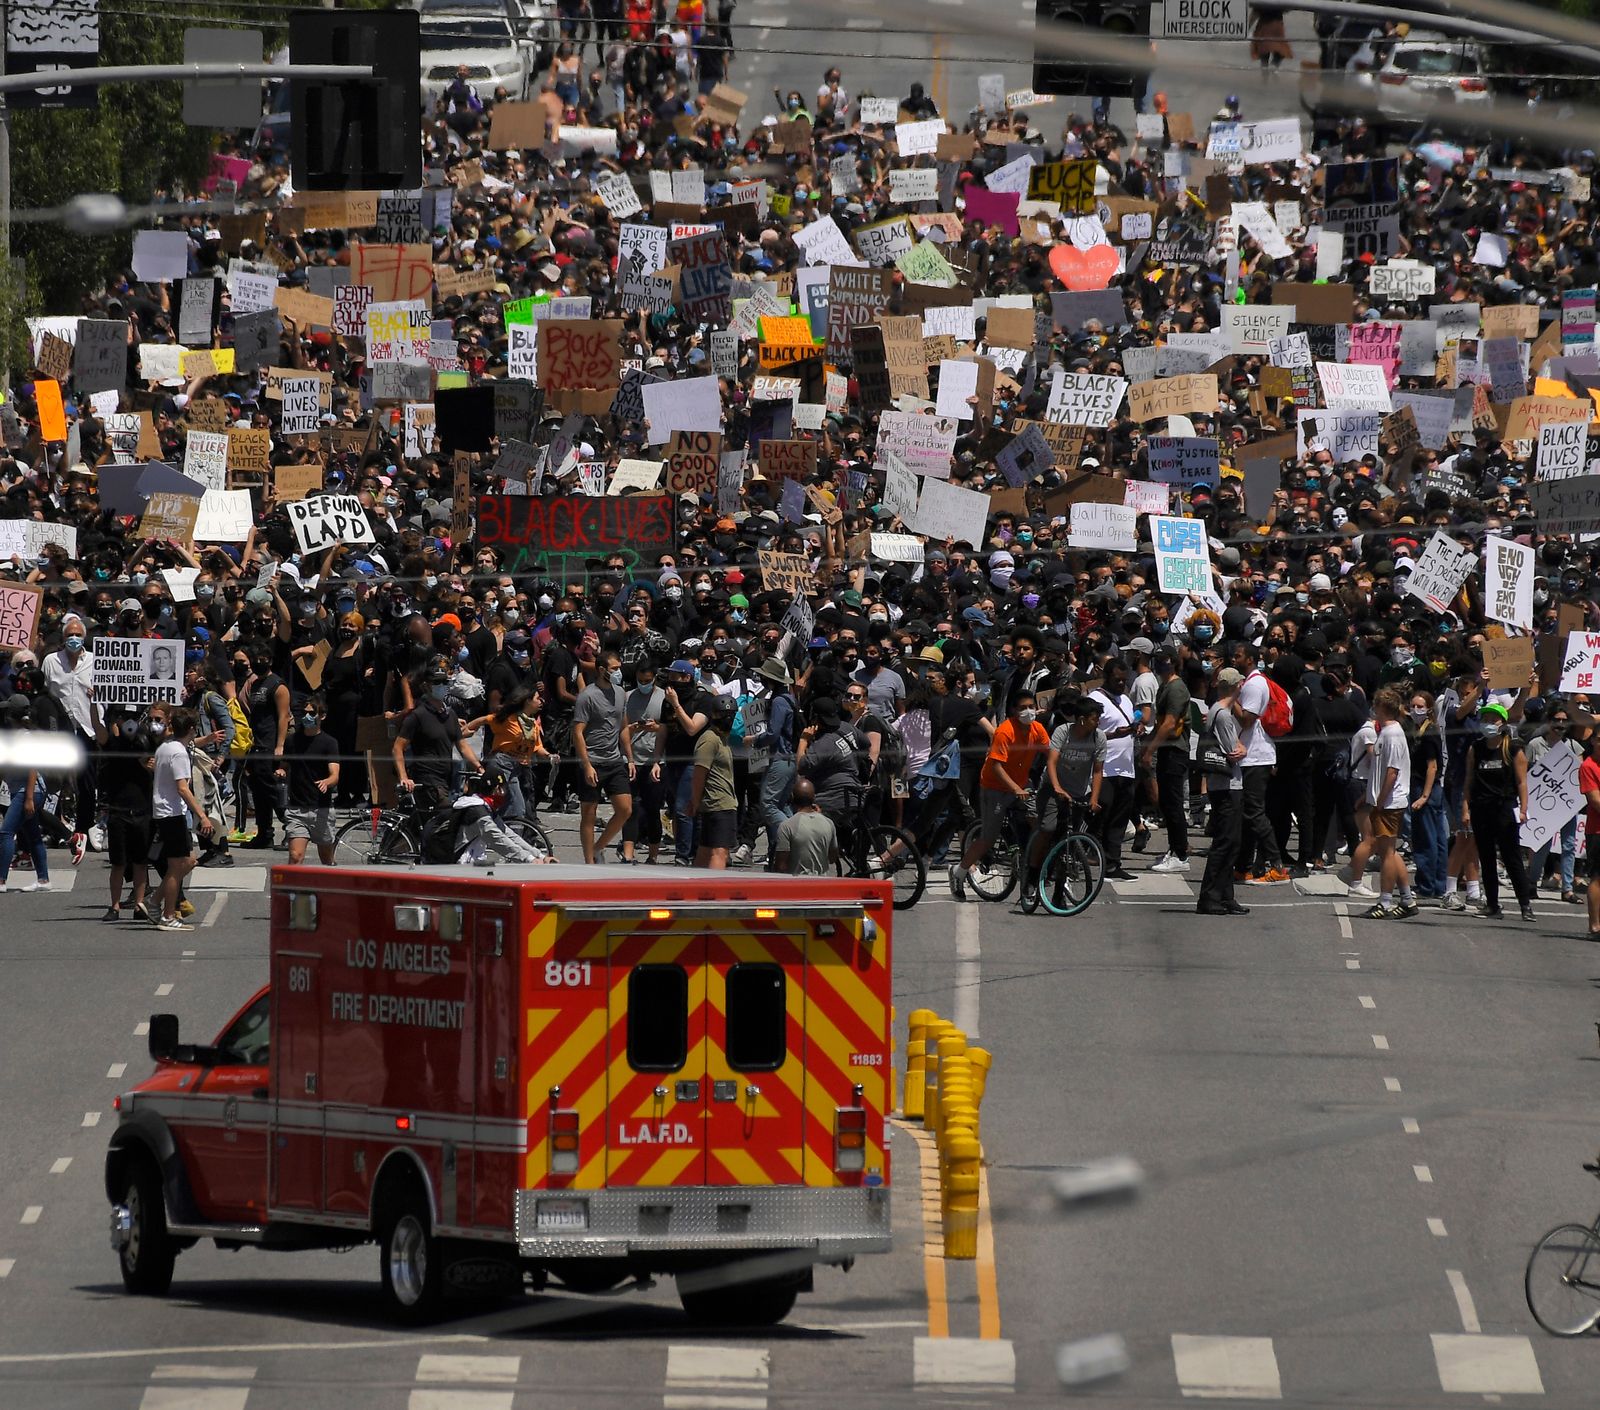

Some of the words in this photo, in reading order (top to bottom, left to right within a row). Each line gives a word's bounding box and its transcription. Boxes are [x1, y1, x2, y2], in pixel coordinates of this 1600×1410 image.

[1179, 0, 1231, 19] BLOCK
[1167, 21, 1243, 35] INTERSECTION
[1031, 161, 1097, 192] FUCK
[738, 187, 759, 202] HOW
[379, 199, 420, 214] ASIANS
[1326, 207, 1365, 222] JACKIE
[1345, 219, 1379, 233] MUST
[620, 239, 642, 249] FOR
[625, 273, 672, 290] RACISM
[834, 272, 882, 291] WHITE
[1374, 268, 1422, 282] STOP
[335, 286, 374, 303] DEATH
[1374, 280, 1432, 293] KILLING
[829, 290, 891, 306] SUPREMACY
[334, 310, 367, 323] POLIC
[368, 311, 409, 329] BLACK
[409, 310, 432, 328] LIVES
[1232, 315, 1281, 327] SILENCE
[336, 322, 367, 335] STAT
[372, 327, 431, 343] MATTER
[1243, 329, 1275, 341] KILLS
[545, 326, 611, 361] Black
[1269, 335, 1309, 355] BLACK
[512, 352, 535, 362] LIV
[762, 346, 795, 361] BLACK
[1272, 352, 1309, 367] LIVES
[510, 364, 535, 376] MATT
[1320, 365, 1341, 379] NO
[284, 380, 316, 395] BLACK
[1063, 374, 1118, 393] BLACK
[1131, 381, 1176, 401] BLACK
[1325, 381, 1345, 396] NO
[283, 395, 318, 412] LIVES
[1060, 393, 1113, 409] LIVES
[1143, 393, 1207, 416] MATTER
[1049, 408, 1113, 427] MATTER
[1517, 402, 1587, 418] AMERICAN
[283, 414, 319, 432] MATTER
[1330, 416, 1379, 432] JUSTICE
[230, 432, 266, 445] BLACK
[677, 431, 713, 453] NO
[1336, 434, 1378, 452] PEACE
[1543, 425, 1582, 446] BLACK
[232, 445, 266, 457] LIVES
[762, 442, 813, 460] BLACK
[1176, 448, 1219, 459] JUSTICE
[1541, 446, 1580, 468] LIVES
[227, 456, 265, 470] MATTER
[669, 453, 718, 476] GOOD
[768, 459, 810, 472] LIVES
[1181, 466, 1212, 478] PEACE
[671, 473, 718, 498] COPS
[293, 496, 362, 520] DEFUND
[1072, 506, 1097, 520] Jail
[1102, 507, 1135, 521] those
[32, 523, 69, 536] BLACK
[479, 495, 590, 550] BLACK
[600, 497, 674, 544] LIVES
[303, 514, 366, 549] LAPD
[1433, 539, 1452, 562] THE
[1419, 554, 1436, 573] IS
[95, 640, 143, 658] BIGOT.
[94, 659, 143, 672] COWARD.
[93, 674, 116, 684] FIRST
[117, 674, 145, 684] DEGREE
[93, 685, 176, 703] MURDERER
[1530, 763, 1575, 809] Justice
[1529, 784, 1557, 811] NO
[346, 938, 377, 968] LOS
[383, 941, 450, 975] ANGELES
[289, 966, 311, 992] 861
[545, 960, 592, 987] 861
[332, 992, 364, 1021] FIRE
[369, 994, 466, 1029] DEPARTMENT
[852, 1053, 883, 1066] 11883
[619, 1123, 693, 1144] L.A.F.D.
